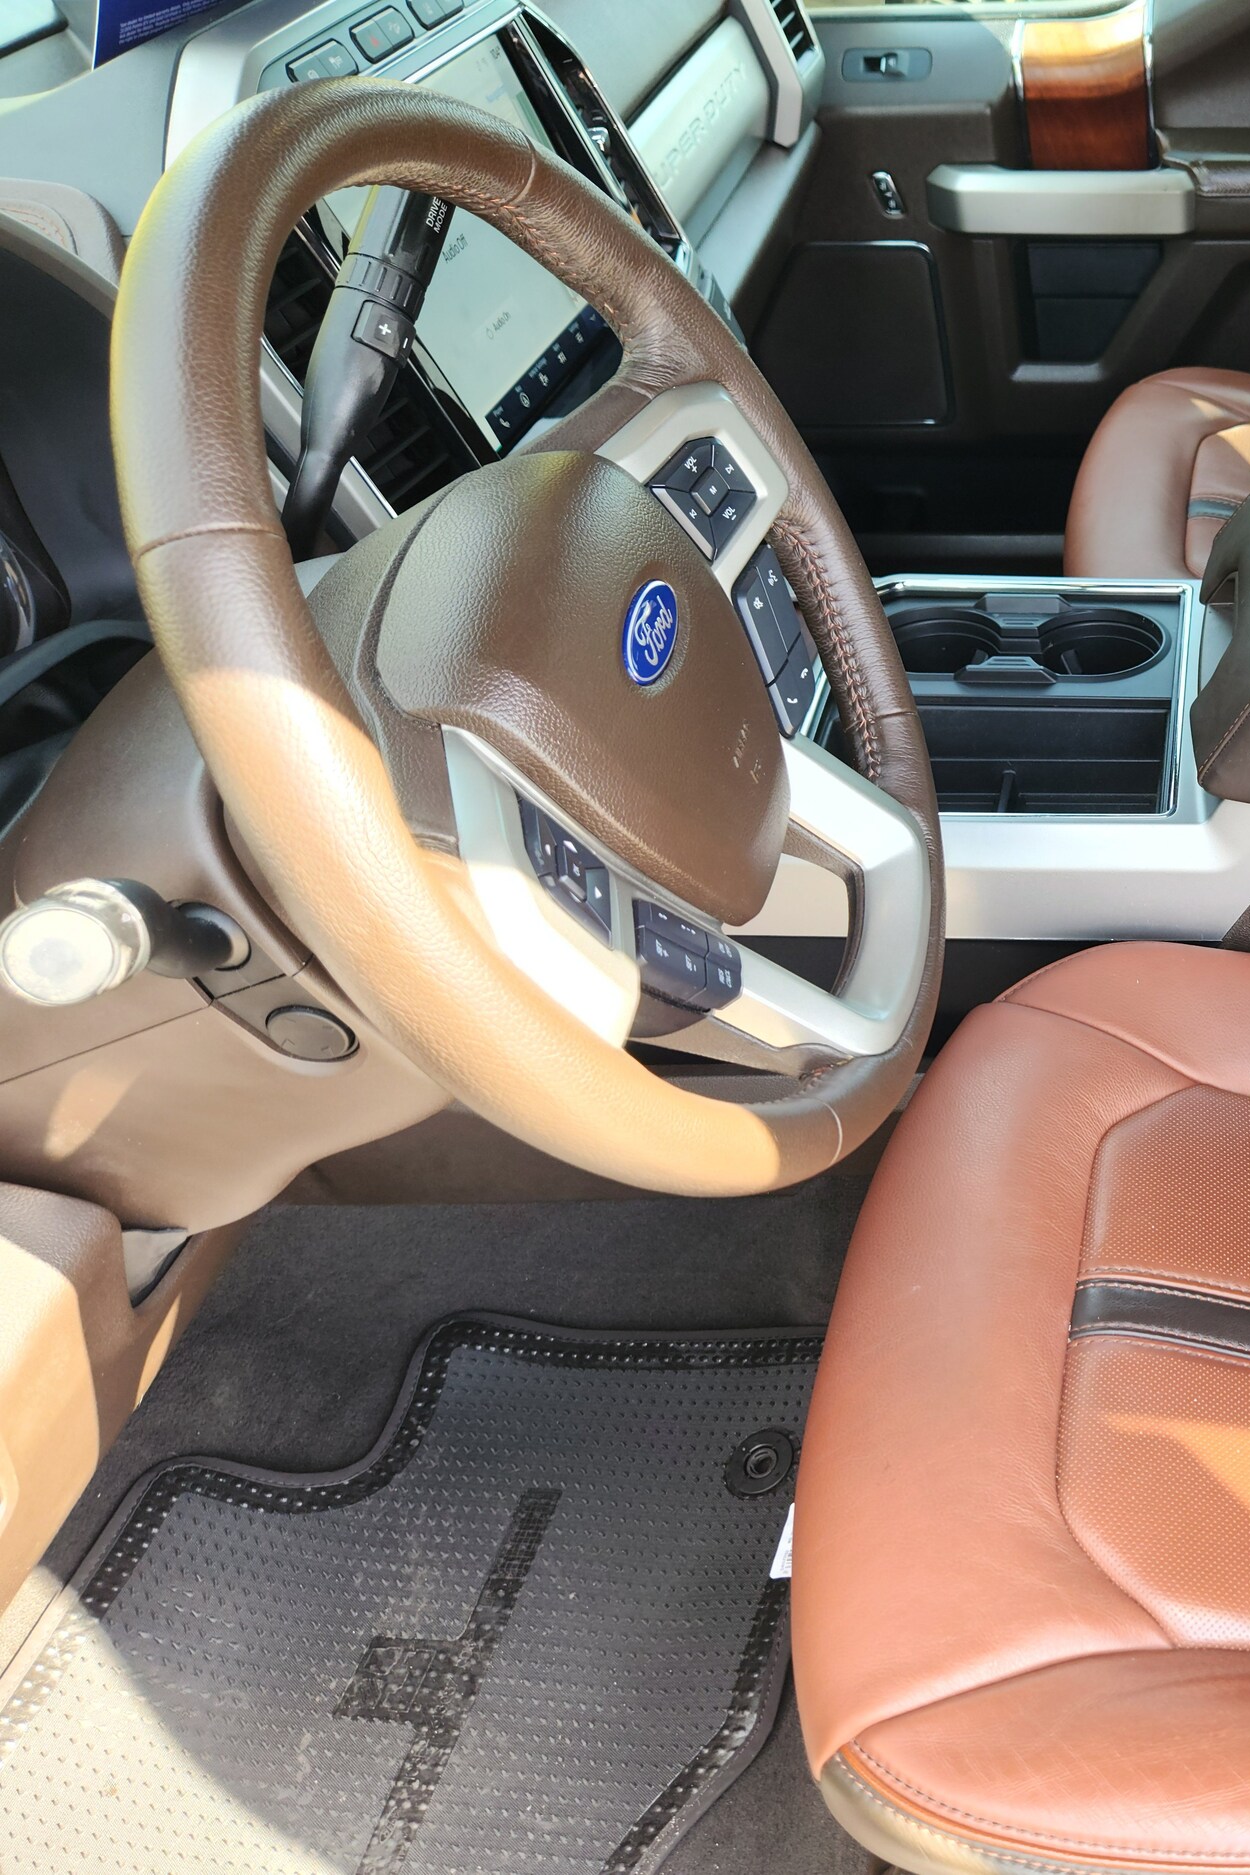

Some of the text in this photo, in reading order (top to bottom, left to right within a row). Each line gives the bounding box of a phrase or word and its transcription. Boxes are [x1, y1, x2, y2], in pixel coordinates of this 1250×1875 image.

[425, 196, 441, 227] DRIVE
[433, 202, 448, 234] MODE
[442, 233, 468, 263] Audio Off
[684, 456, 697, 470] VOL
[709, 485, 718, 496] M
[722, 506, 736, 519] VOL
[633, 594, 674, 667] Ford
